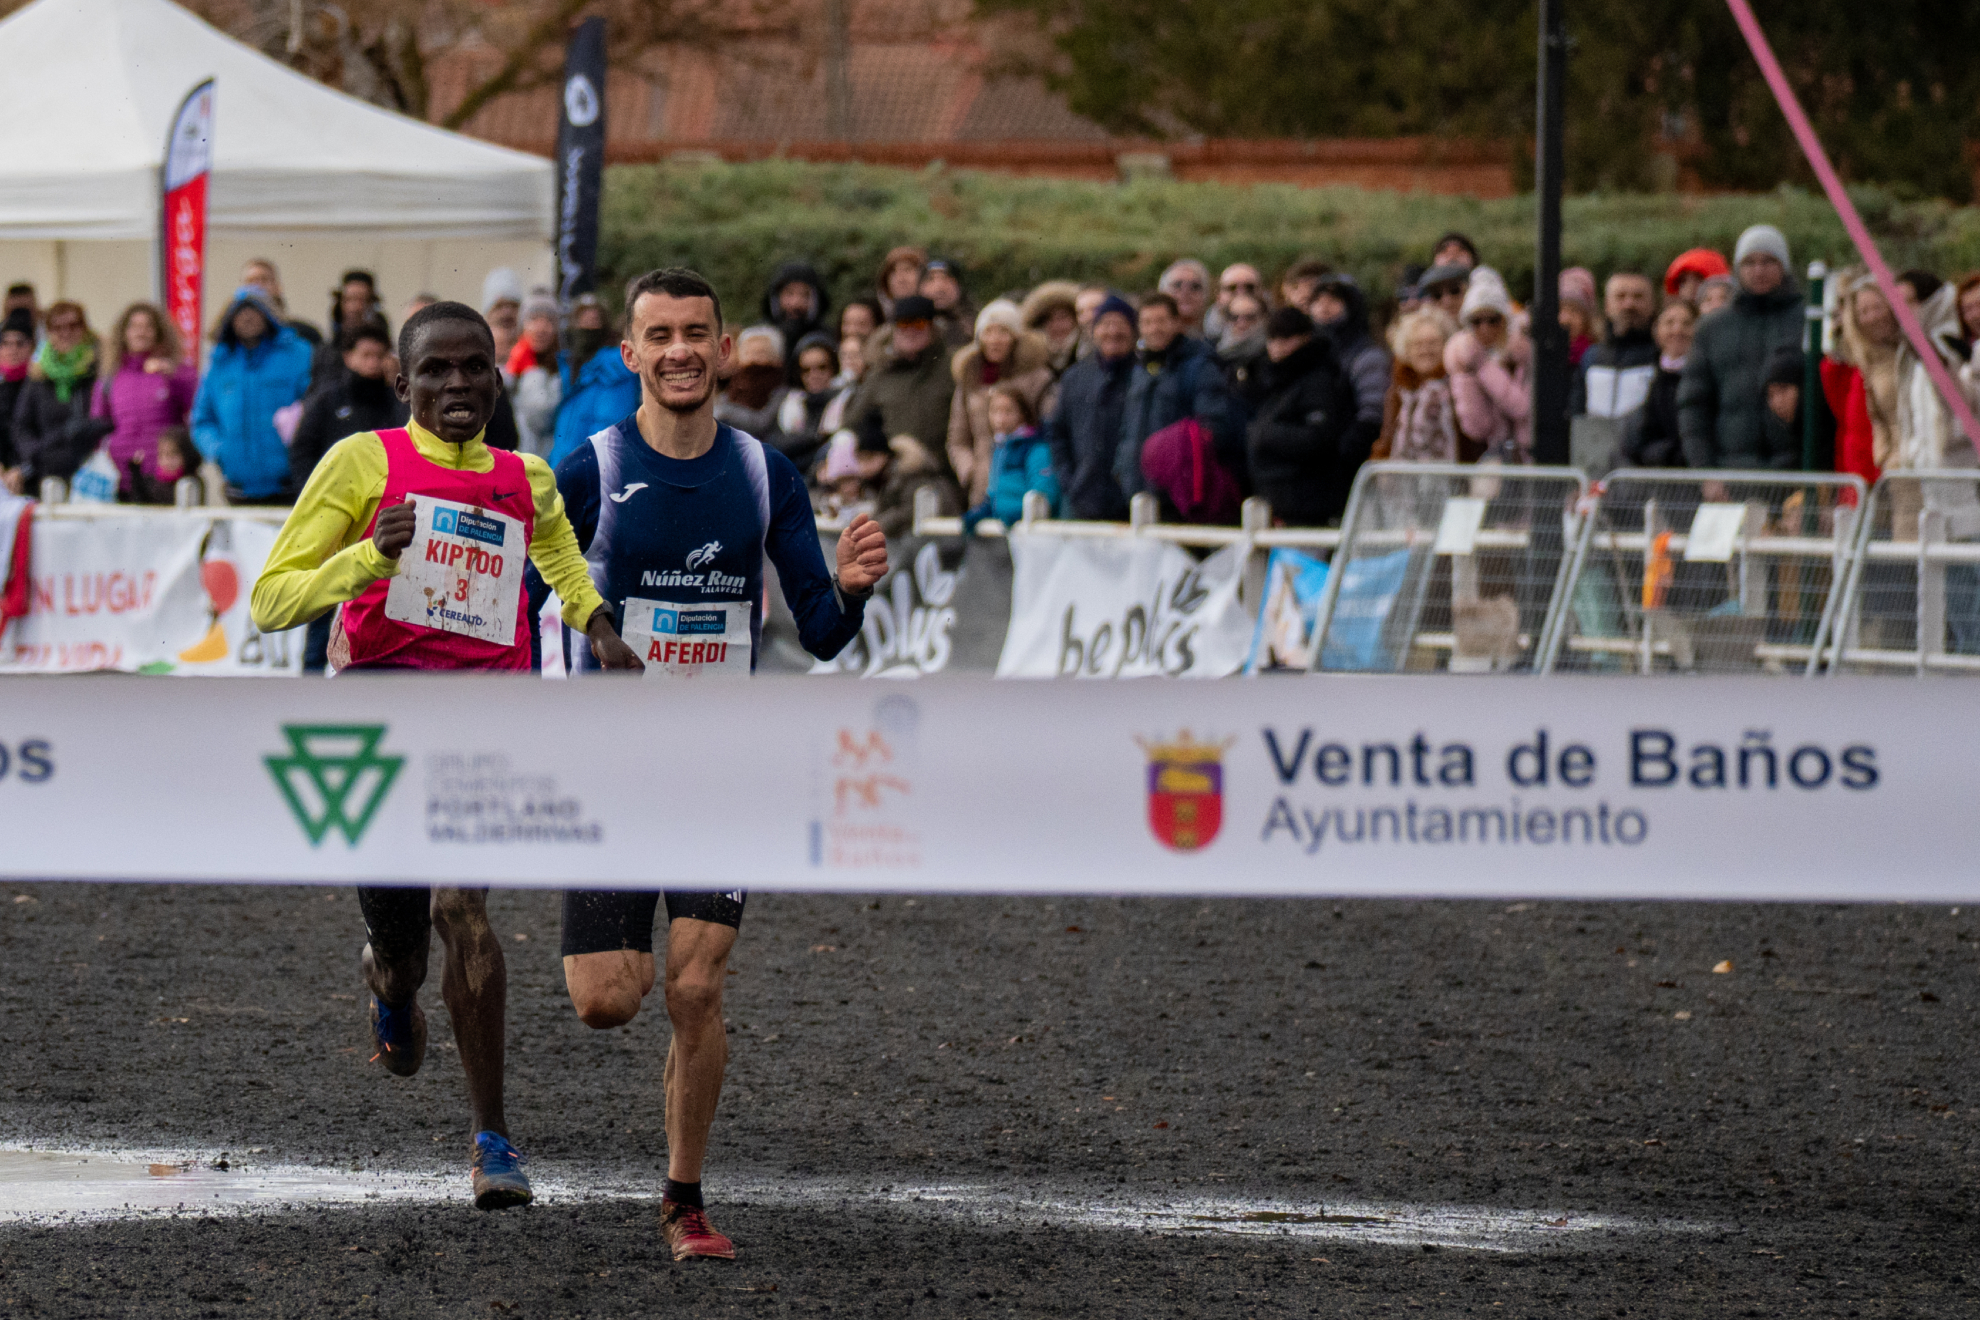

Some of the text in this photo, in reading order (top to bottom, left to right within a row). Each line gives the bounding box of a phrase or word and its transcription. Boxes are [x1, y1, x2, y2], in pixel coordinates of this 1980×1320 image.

[460, 515, 498, 532] Diputación
[458, 525, 503, 543] DE PALENCIA
[425, 538, 504, 579] KIPTOO
[640, 569, 747, 588] Núñez Run
[454, 578, 469, 602] 3
[701, 586, 744, 595] TALAVERA
[439, 607, 484, 627] CEREALTO
[680, 613, 718, 624] Diputación
[679, 623, 725, 632] DE PALENCIA
[647, 639, 728, 665] AFERDI
[1260, 727, 1881, 791] Venta de Baños
[1260, 796, 1650, 855] Ayuntamiento
